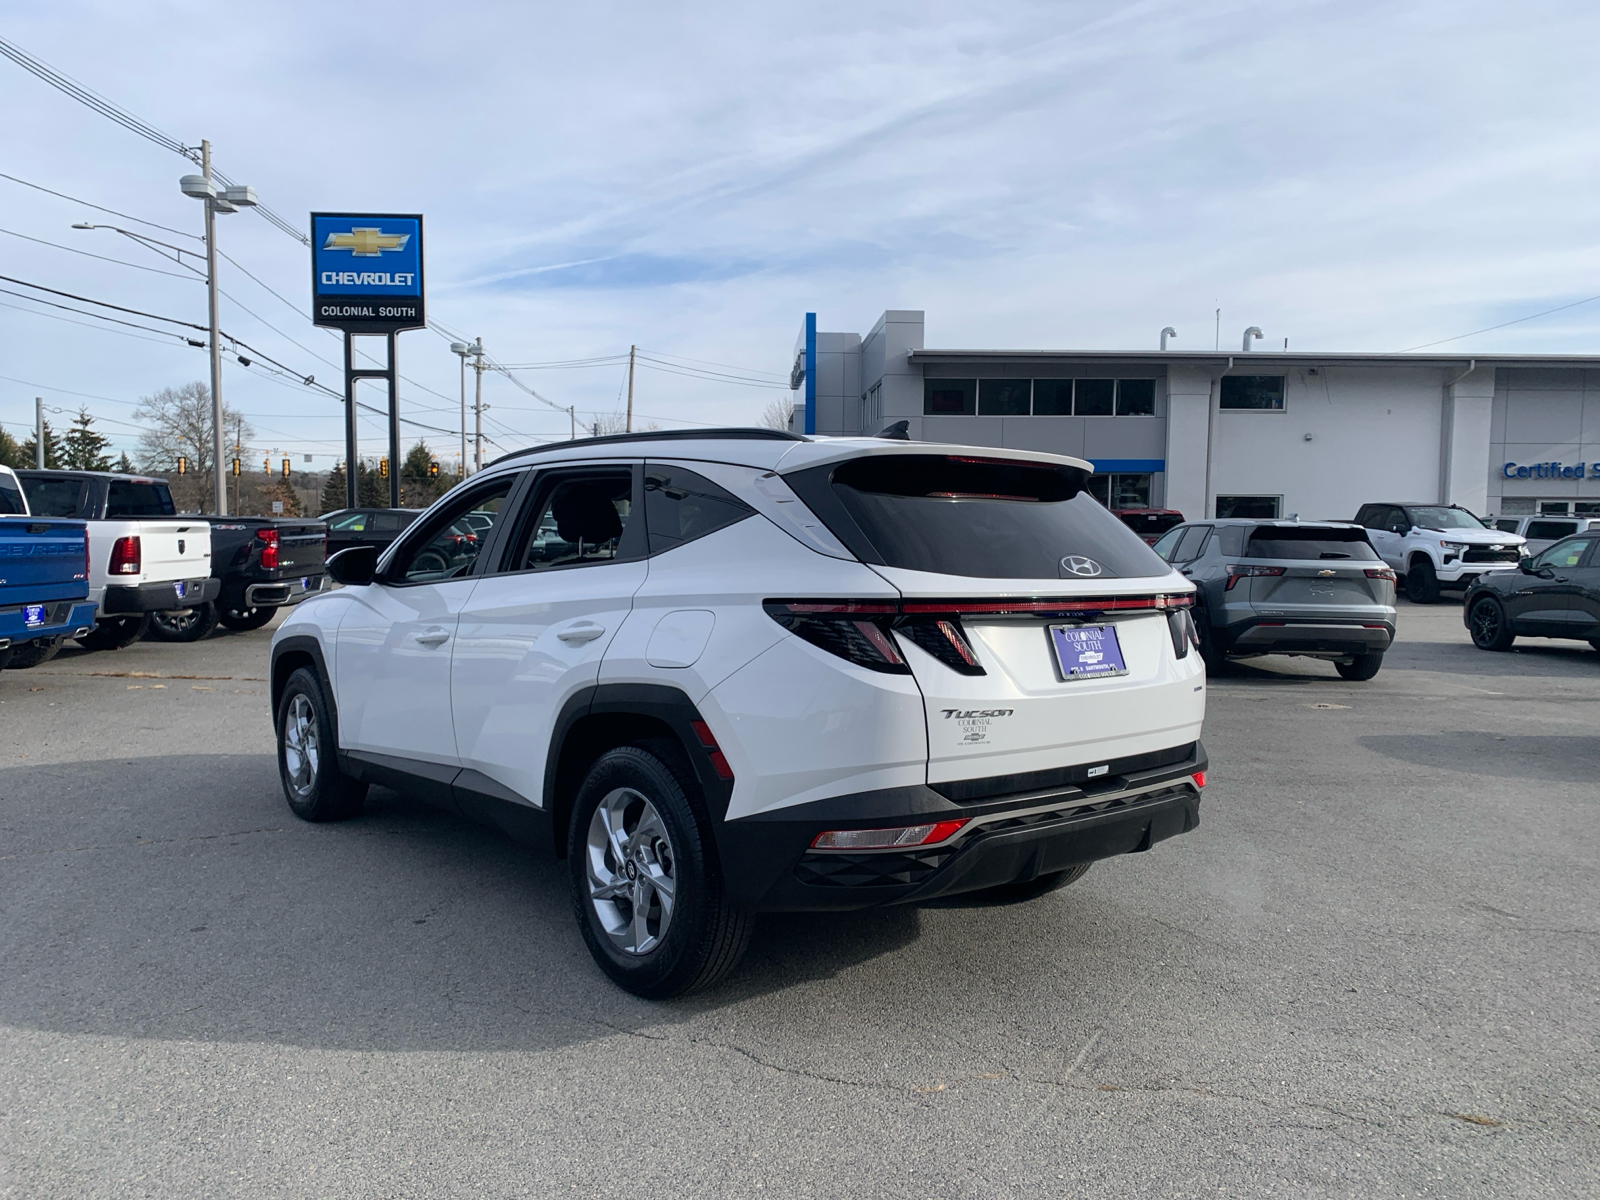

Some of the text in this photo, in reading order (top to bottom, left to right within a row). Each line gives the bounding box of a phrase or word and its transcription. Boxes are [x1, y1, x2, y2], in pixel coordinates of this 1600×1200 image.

[321, 271, 415, 286] CHEVROLET
[321, 306, 416, 317] COLONIAL SOUTH
[1503, 462, 1586, 478] Certified
[1065, 630, 1105, 642] COLONIAL
[1074, 640, 1102, 652] SOUTH
[958, 718, 992, 727] COLONIAL
